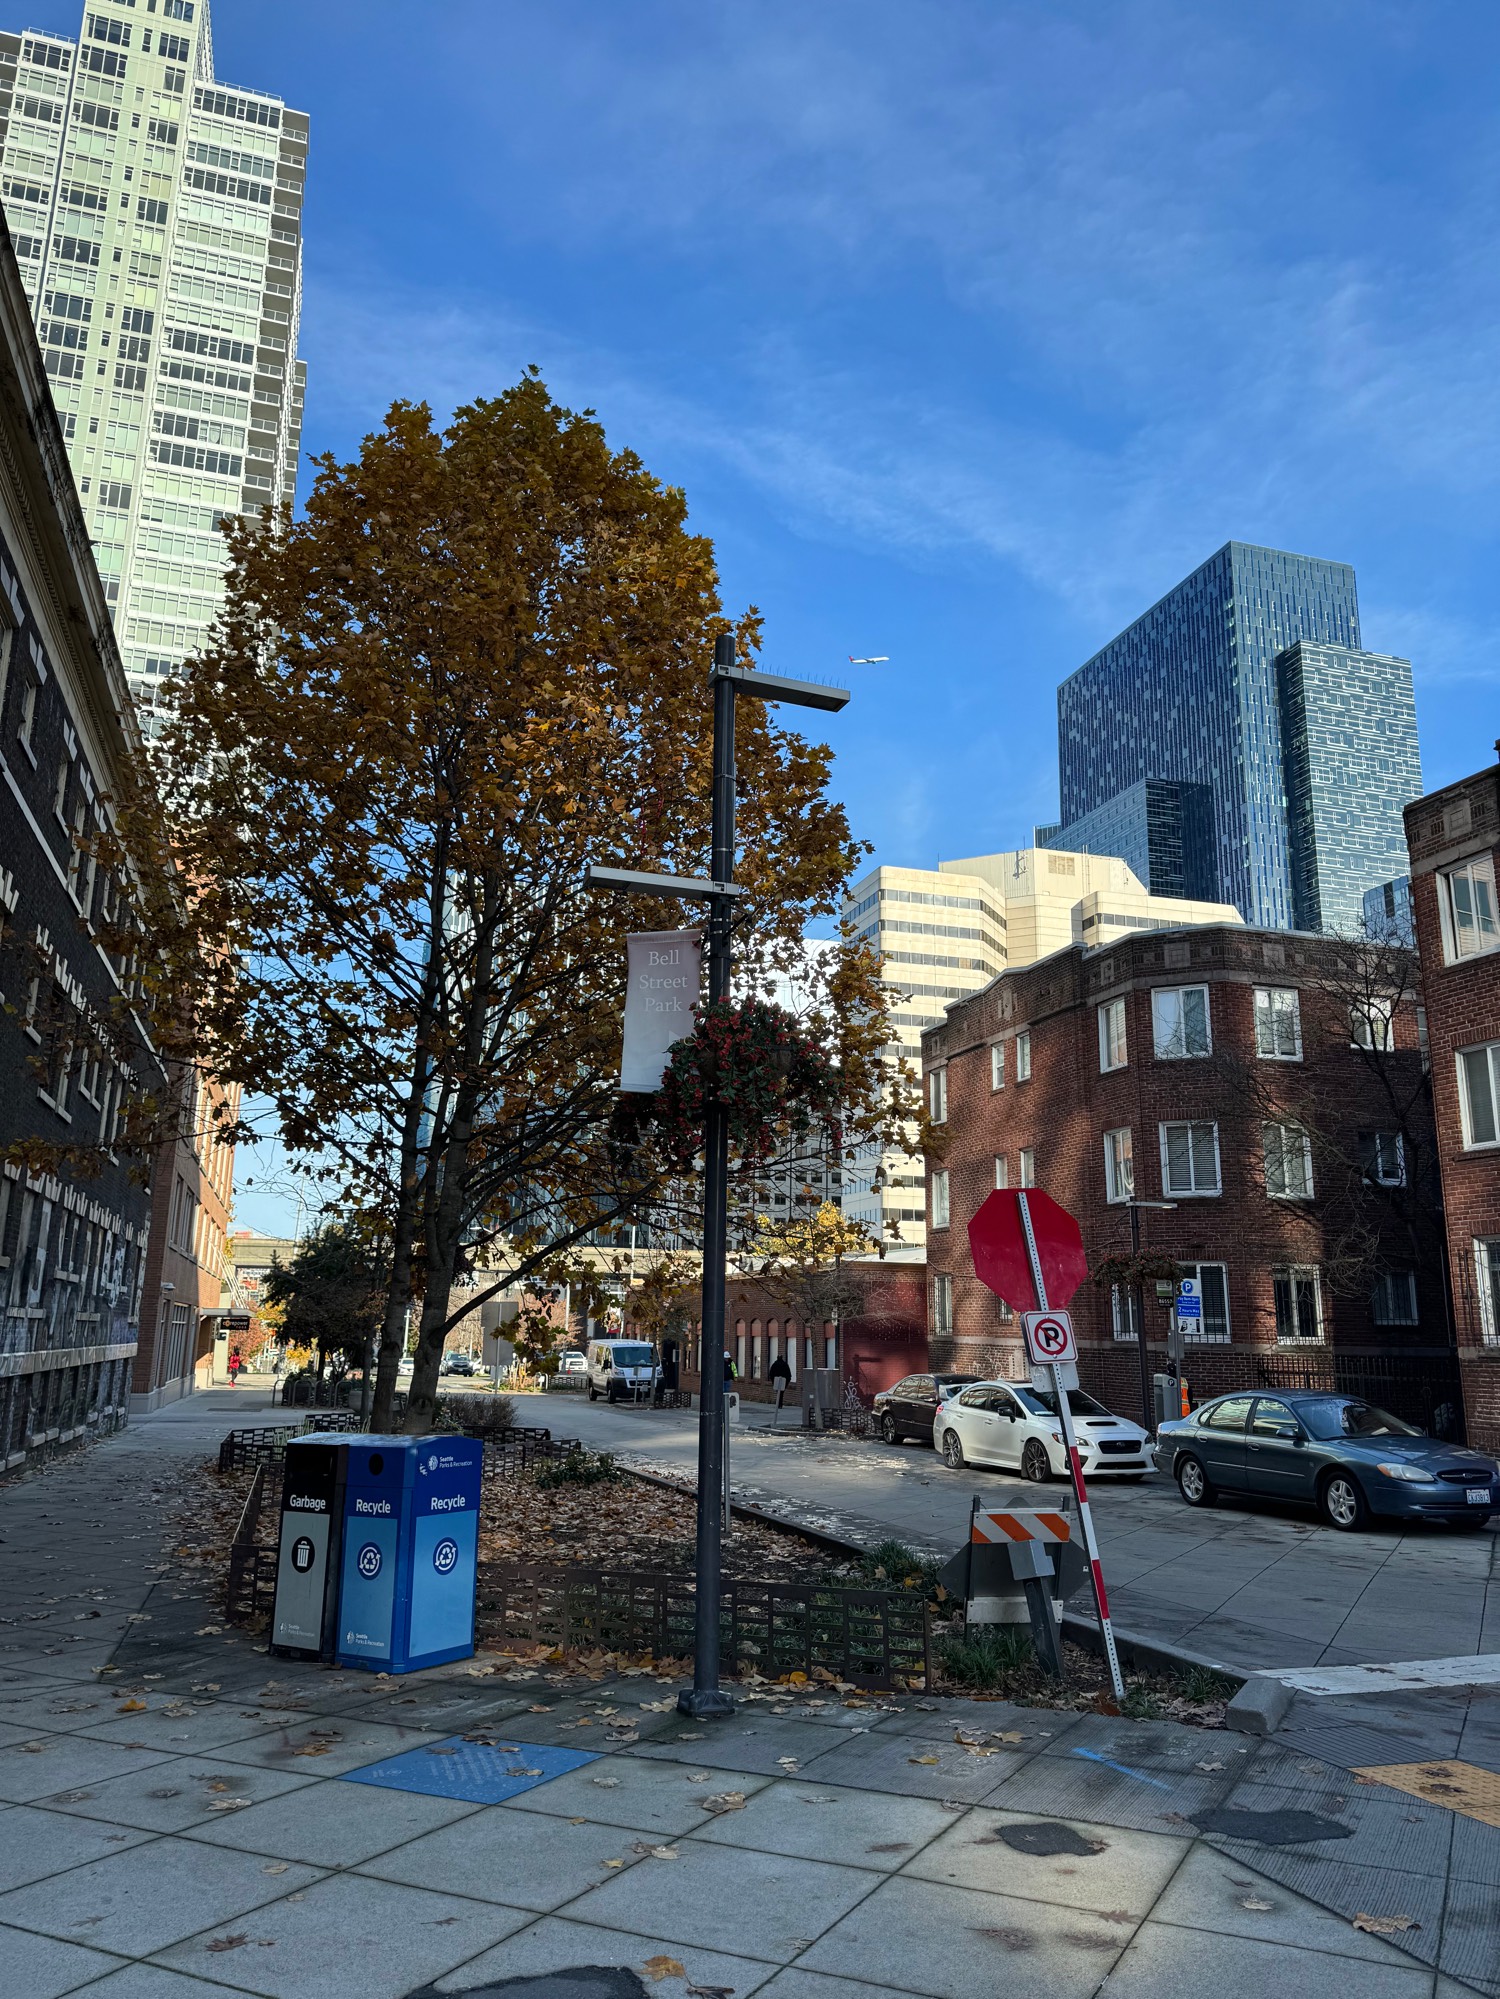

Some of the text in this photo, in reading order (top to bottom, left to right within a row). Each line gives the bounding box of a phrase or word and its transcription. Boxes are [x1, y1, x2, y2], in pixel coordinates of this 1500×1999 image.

[648, 949, 681, 966] Bell
[639, 974, 689, 989] Street
[644, 996, 683, 1012] Park
[1185, 1283, 1192, 1292] P
[1043, 1327, 1060, 1348] P
[289, 1494, 326, 1512] Garbage
[355, 1498, 391, 1515] Recycle
[430, 1494, 466, 1511] Recycle
